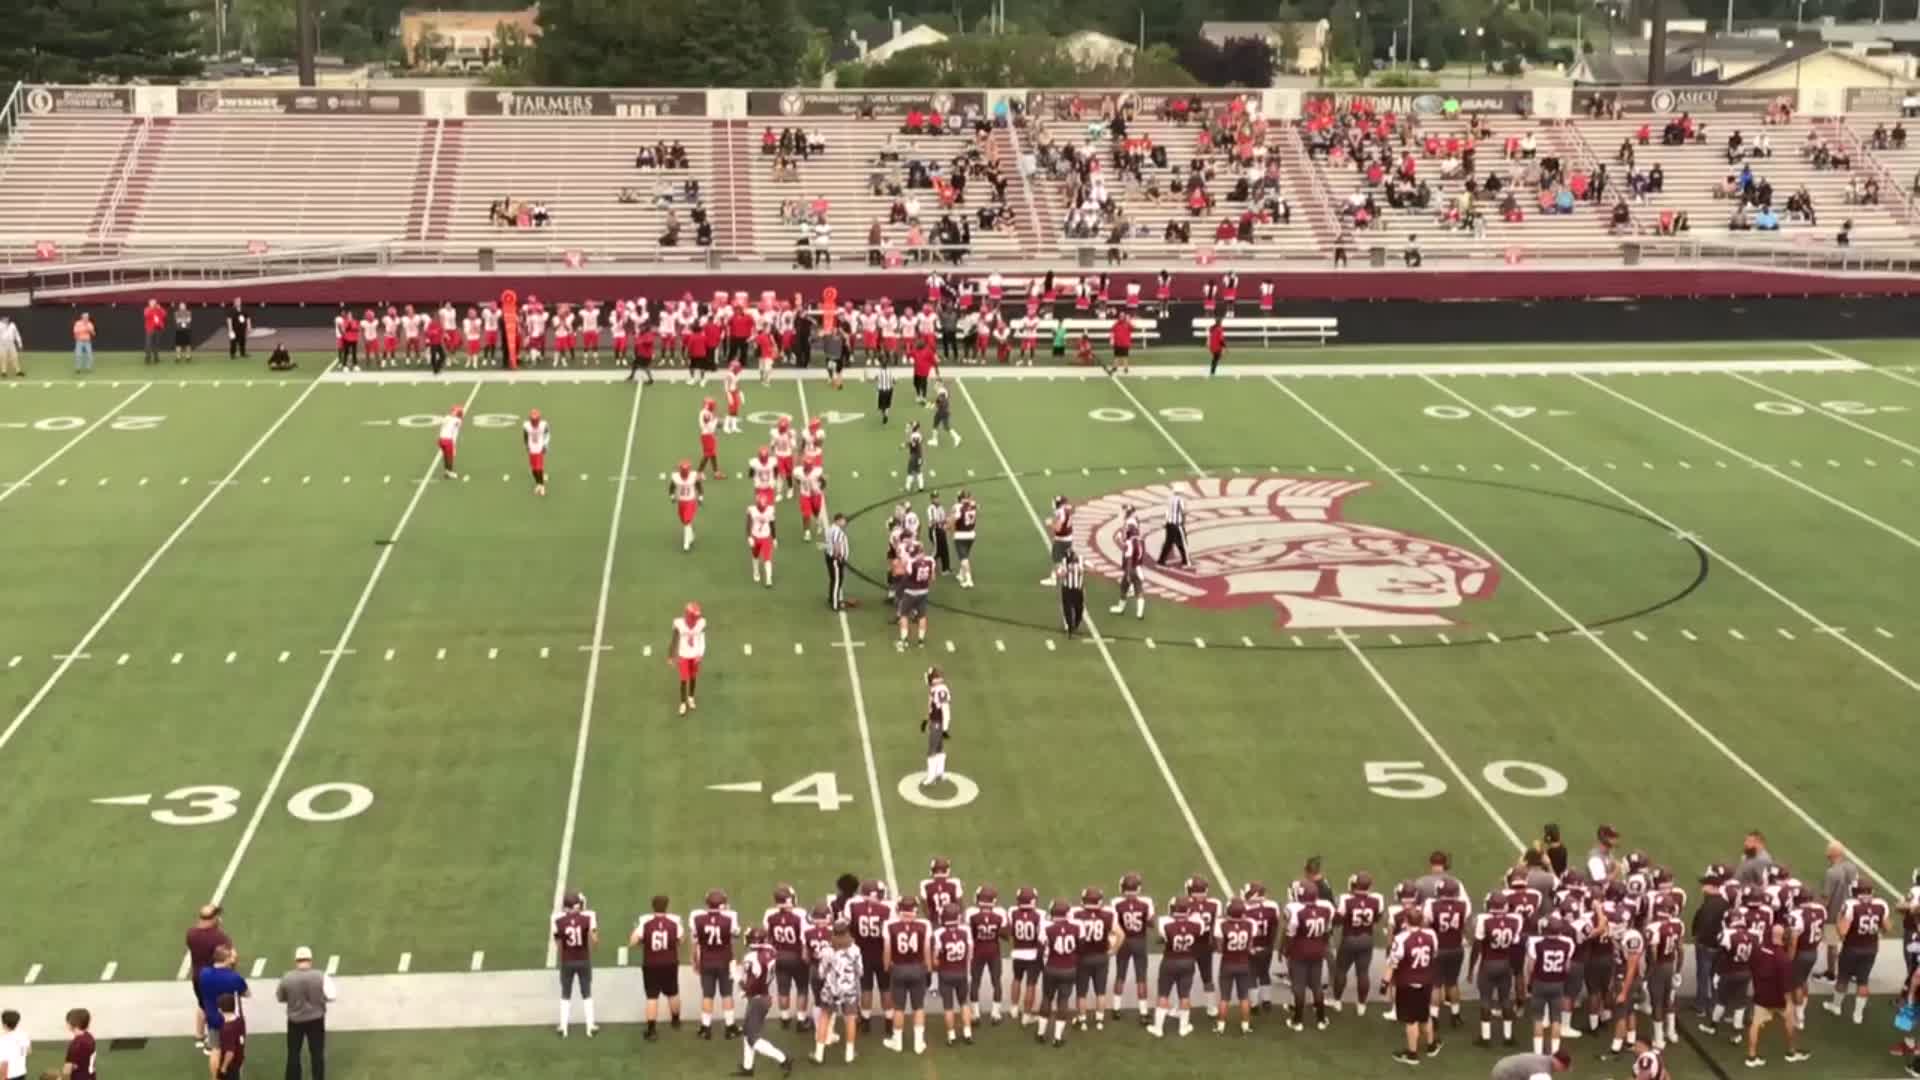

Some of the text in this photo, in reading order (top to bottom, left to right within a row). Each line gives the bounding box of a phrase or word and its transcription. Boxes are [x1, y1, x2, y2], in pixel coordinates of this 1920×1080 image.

[515, 94, 594, 111] FARMERS
[1334, 93, 1413, 113] BODMAN
[858, 915, 880, 937] 65
[1306, 917, 1327, 938] 70
[1351, 908, 1374, 927] 53
[1439, 912, 1461, 932] 54
[564, 925, 583, 947] 31
[704, 925, 722, 945] 71
[1014, 919, 1035, 940] 80
[1083, 919, 1104, 941] 78
[1490, 927, 1513, 949] 30
[651, 930, 669, 952] 61
[897, 931, 919, 954] 64
[944, 940, 966, 962] 29
[1053, 935, 1075, 955] 40
[1173, 933, 1195, 951] 62
[1227, 930, 1249, 951] 28
[1410, 945, 1431, 969] 76
[1542, 949, 1565, 973] 52
